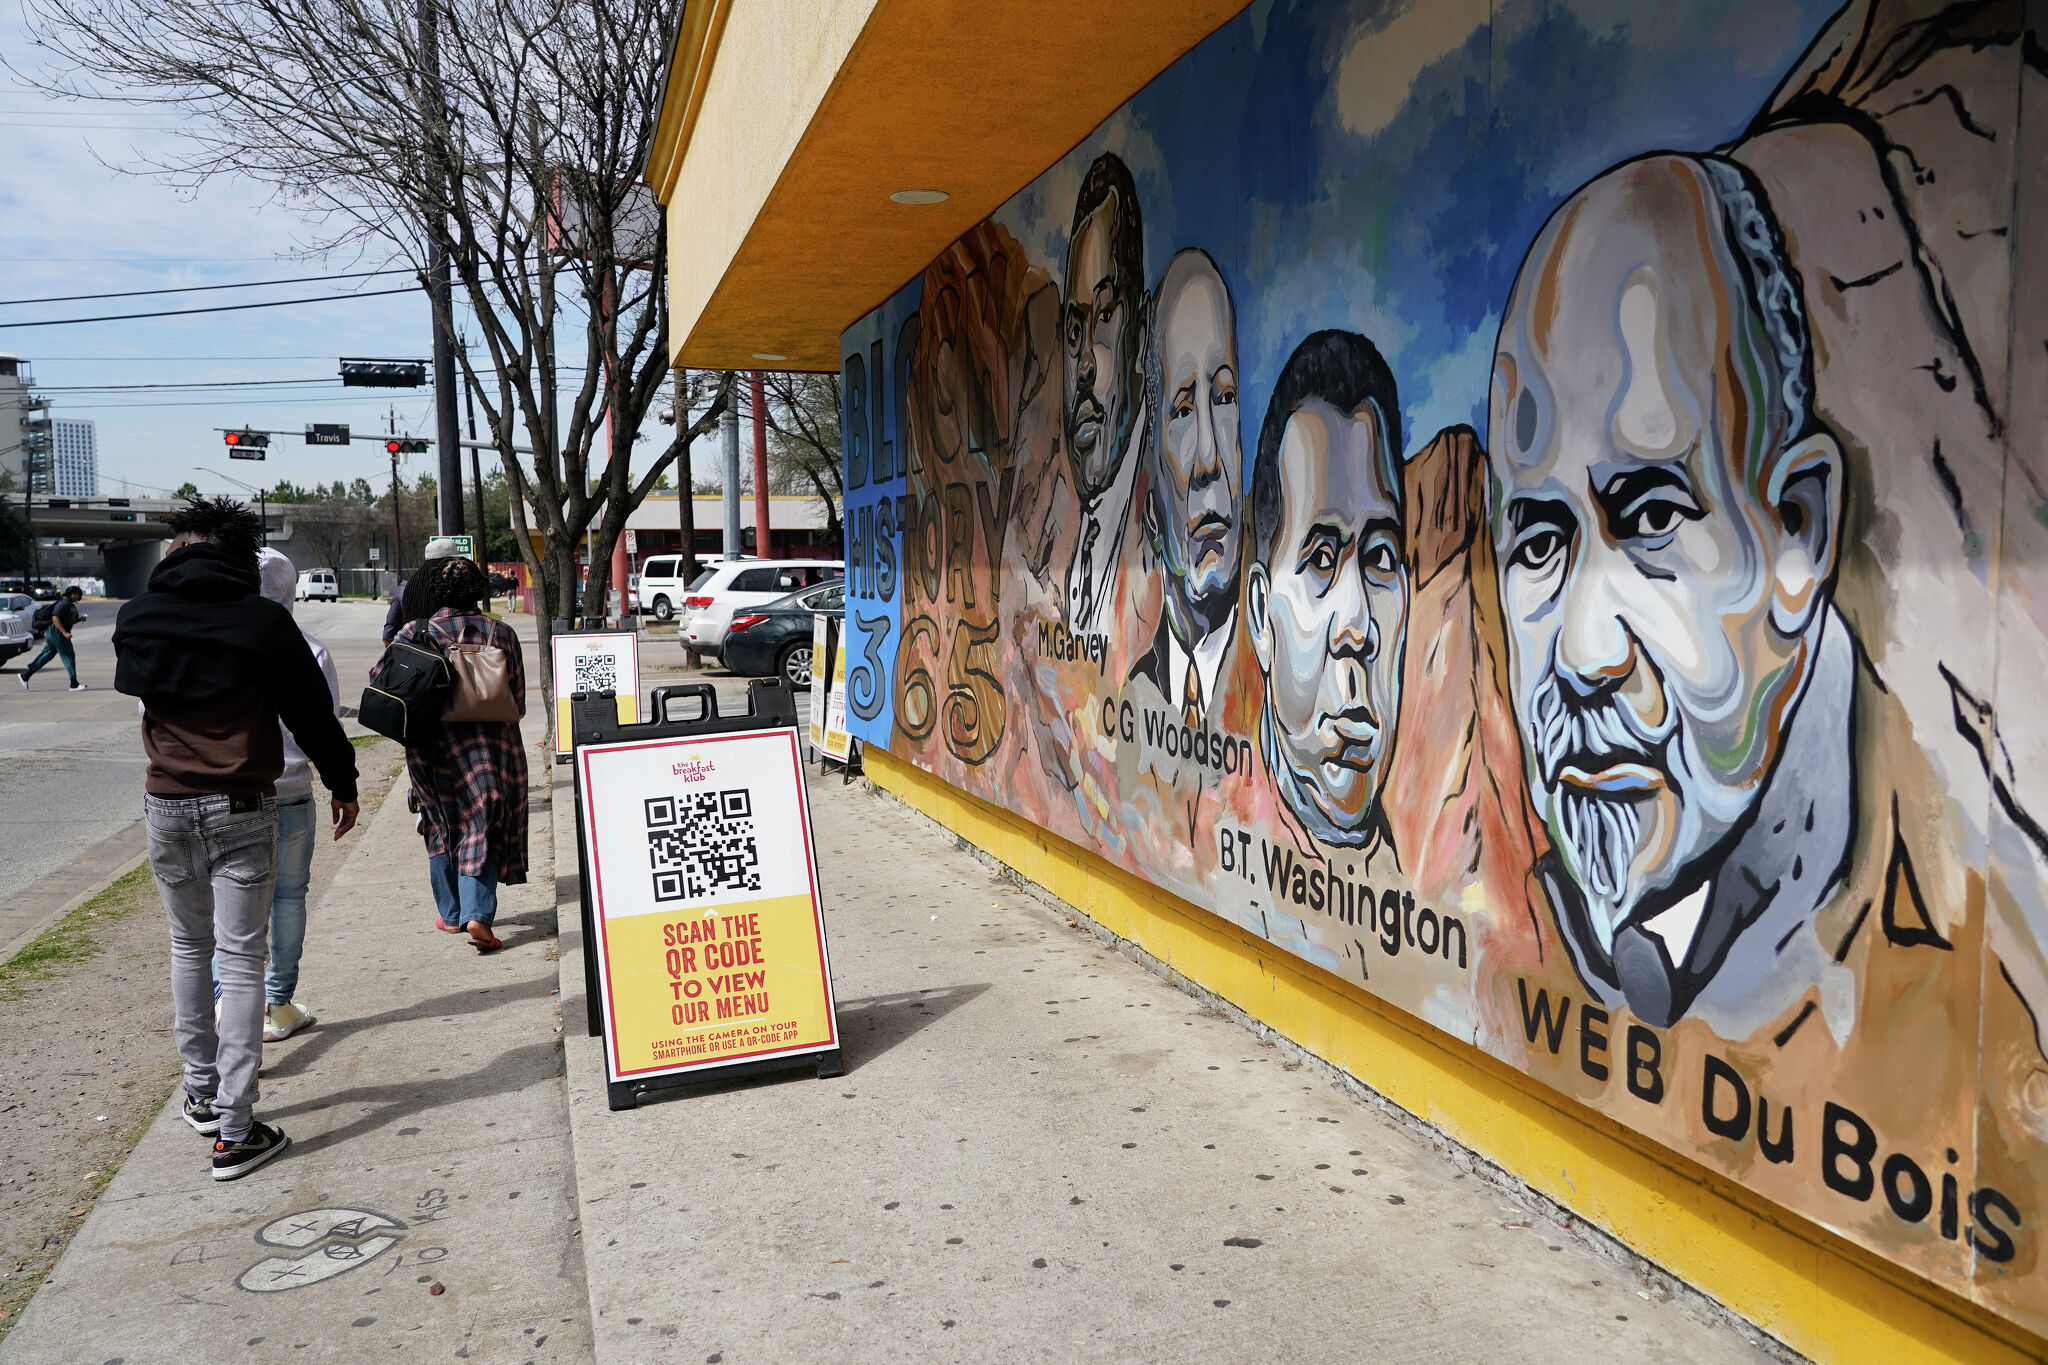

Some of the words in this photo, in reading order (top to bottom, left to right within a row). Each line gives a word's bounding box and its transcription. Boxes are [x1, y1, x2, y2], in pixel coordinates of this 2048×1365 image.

[315, 433, 340, 443] Travis
[848, 465, 1016, 609] HISTORY
[1038, 621, 1109, 678] M.Garvey
[848, 610, 1007, 766] 365
[1103, 696, 1116, 737] C
[1119, 699, 1134, 744] G
[1143, 708, 1253, 778] Woodson
[672, 760, 716, 776] breakfast
[684, 772, 706, 783] klub
[1262, 838, 1467, 969] Washington
[663, 918, 717, 947] SCAN
[721, 912, 761, 939] THE
[665, 946, 698, 980] QR
[704, 937, 765, 971] CODE
[669, 979, 703, 1001] TO
[706, 969, 766, 995] VIEW
[671, 1000, 710, 1026] OUR
[715, 991, 769, 1020] MENU
[651, 1037, 684, 1050] USING
[685, 1034, 705, 1045] THE
[708, 1028, 750, 1041] CAMERA
[752, 1025, 767, 1035] ON
[770, 1020, 798, 1032] YOUR
[652, 1043, 708, 1061] SMARTPHONE
[709, 1041, 720, 1052] OR
[721, 1038, 738, 1050] USE
[739, 1037, 745, 1048] A
[746, 1032, 782, 1047] QR-CODE
[783, 1029, 799, 1041] APP
[1517, 977, 1664, 1104] WEB
[1702, 1053, 1795, 1165] Du
[1821, 1100, 2021, 1264] Bois
